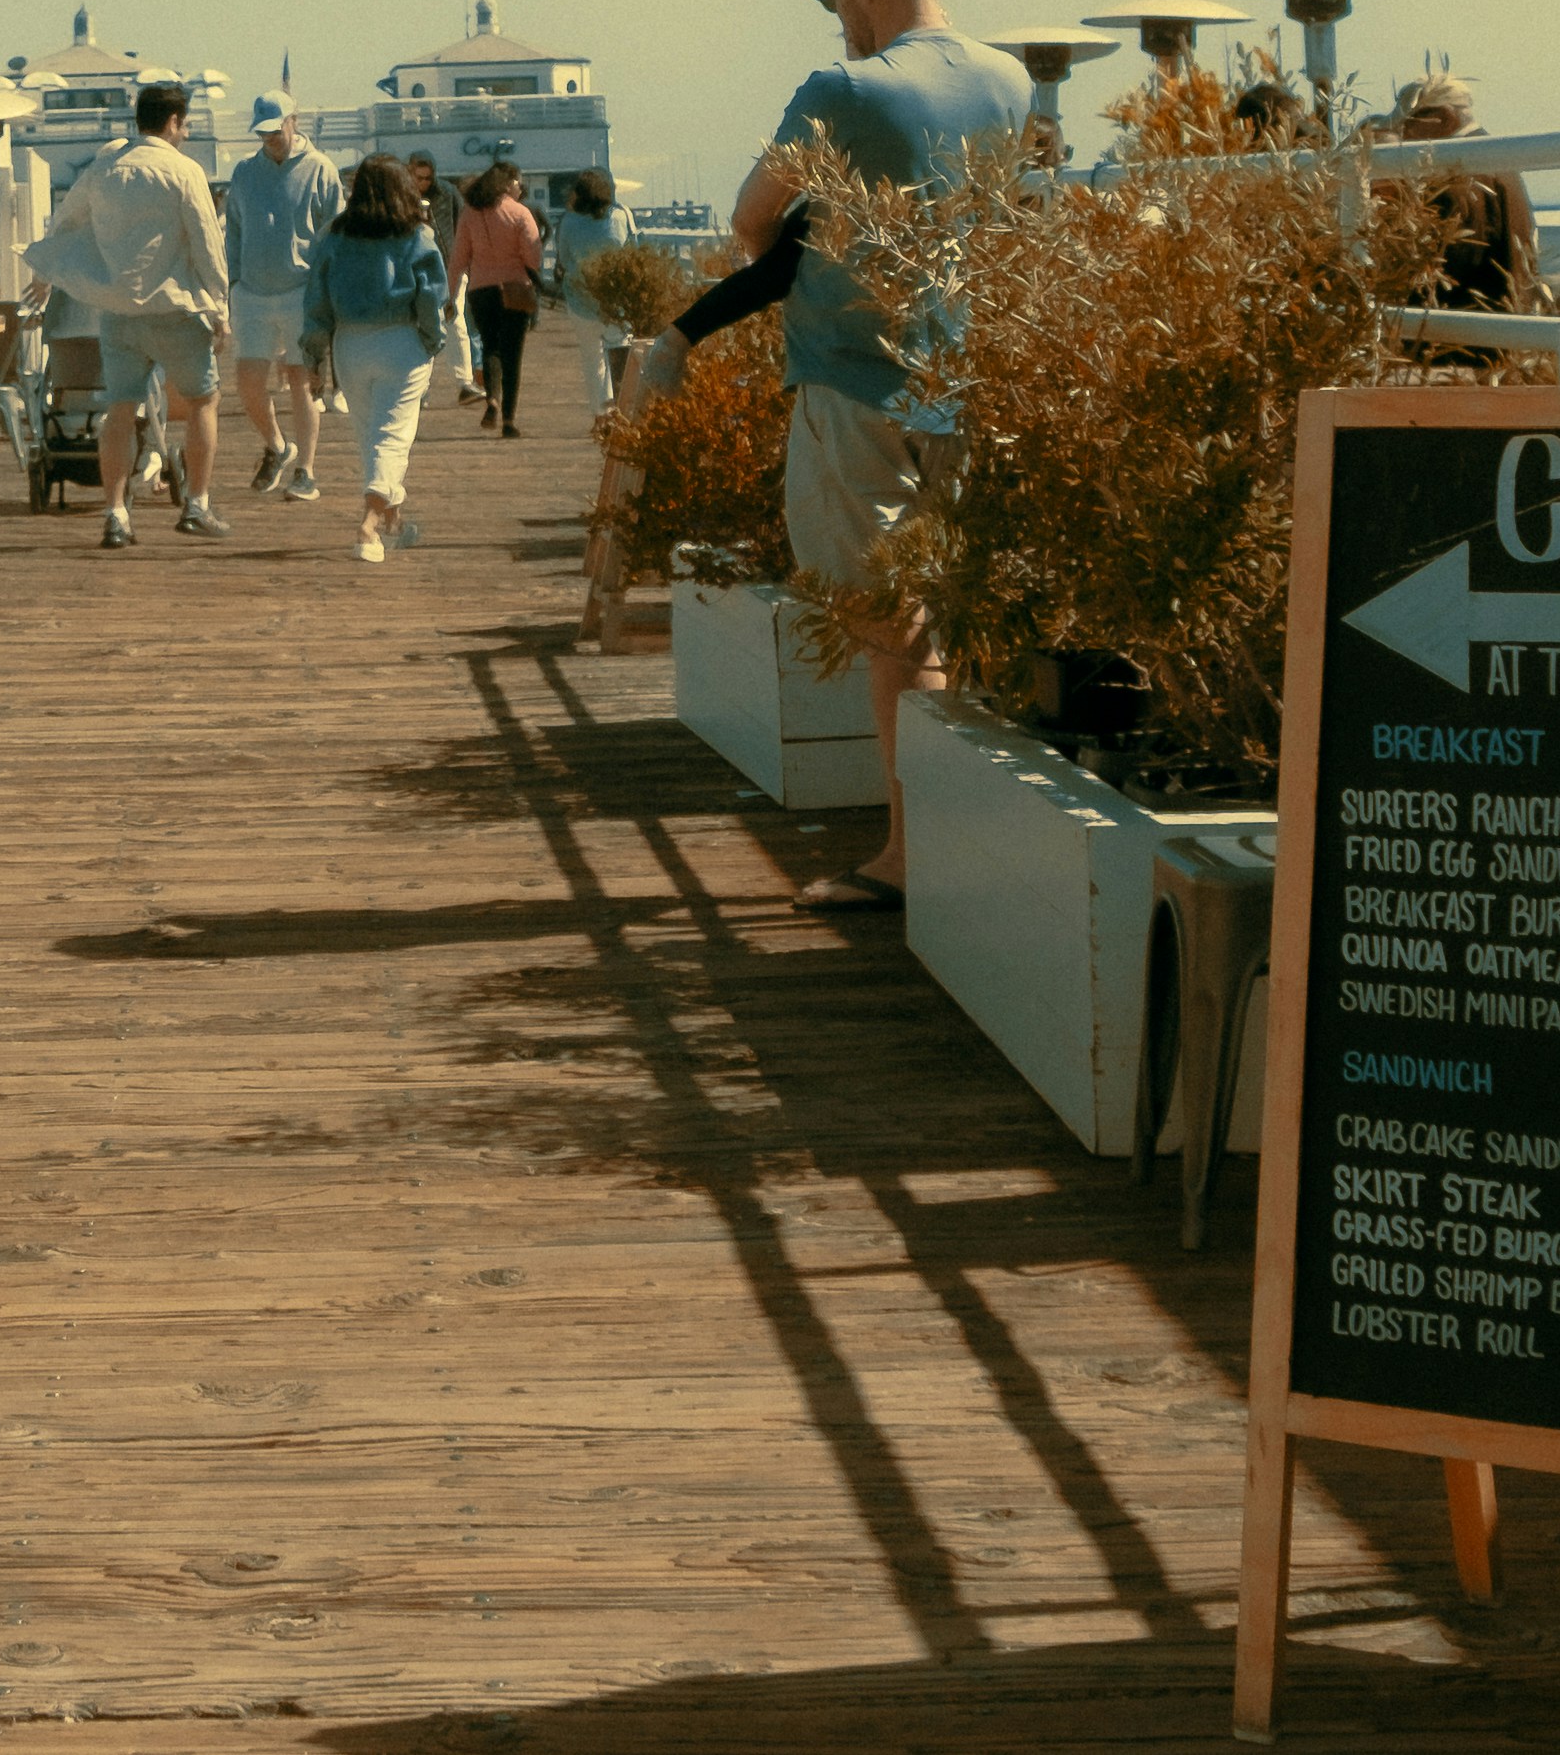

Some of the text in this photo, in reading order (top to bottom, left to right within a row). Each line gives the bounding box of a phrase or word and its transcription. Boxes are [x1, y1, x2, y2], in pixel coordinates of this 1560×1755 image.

[1488, 645, 1527, 695] AT
[1373, 724, 1545, 765] BREAKFAST
[1341, 789, 1457, 831] SURFERS
[1346, 835, 1421, 873] FRIED
[1429, 839, 1476, 878] EGG
[1344, 885, 1496, 935] BREAKFAST
[1342, 933, 1447, 972] QUINOA
[1339, 980, 1455, 1022] SWEDISH
[1465, 991, 1525, 1028] MINI
[1343, 1051, 1492, 1094] SANDWICH
[1334, 1164, 1540, 1220] SKIRT STEAK
[1333, 1209, 1487, 1257] GRASS-FED
[1332, 1253, 1425, 1297] GRILED
[1435, 1266, 1542, 1310] SHRIMP
[1333, 1301, 1544, 1358] LOBSTER ROLL
